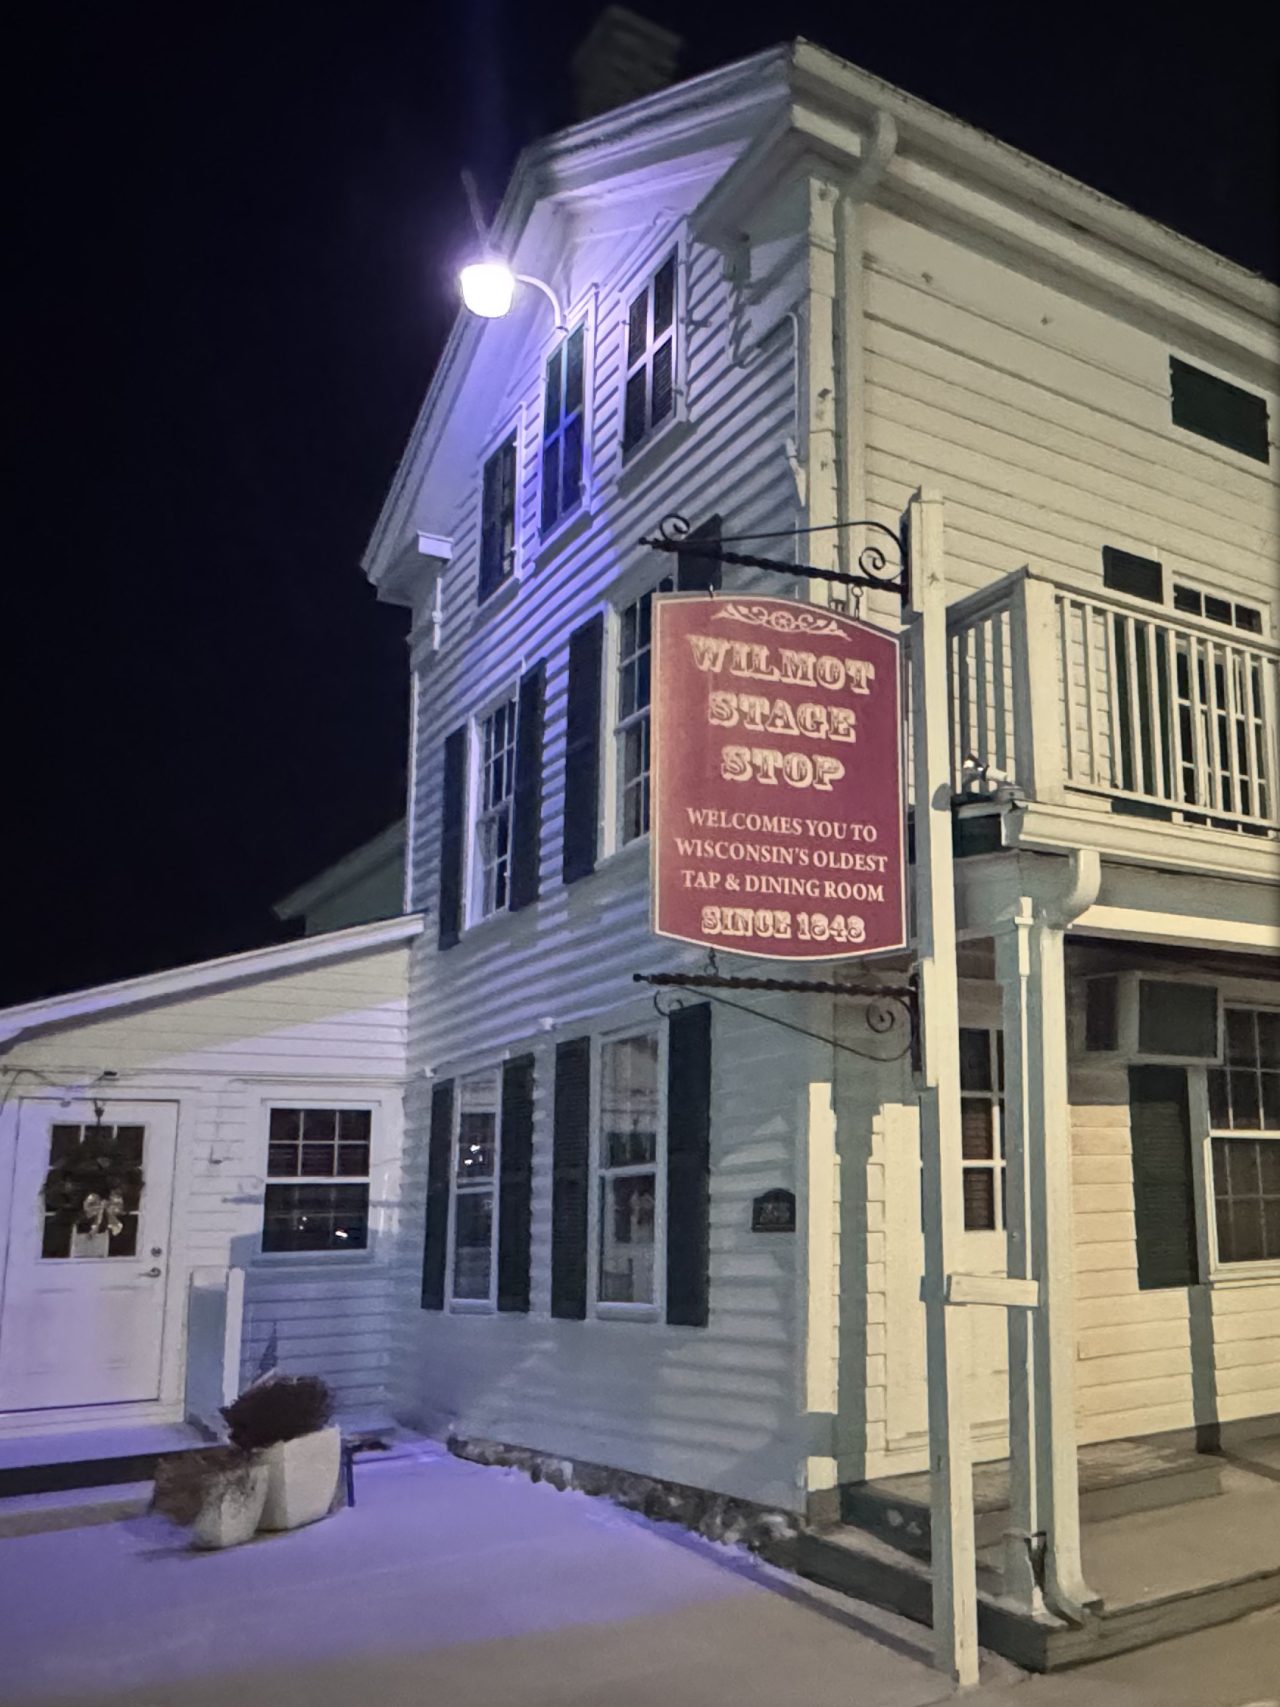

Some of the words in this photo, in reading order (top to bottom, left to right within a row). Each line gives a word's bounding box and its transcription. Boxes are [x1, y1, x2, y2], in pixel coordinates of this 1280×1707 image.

[688, 635, 875, 694] WILMOT
[709, 691, 857, 743] STAGE
[721, 745, 846, 792] STOP
[686, 807, 802, 836] WELCOMES
[805, 818, 847, 840] YOU
[850, 824, 878, 843] TO
[675, 837, 809, 867] WISCONSIN'S
[813, 849, 889, 873] OLDEST
[681, 870, 721, 889] TAP
[724, 873, 740, 891] &
[744, 874, 820, 898] DINING
[823, 880, 885, 902] ROOM
[701, 905, 792, 939] SINCE
[796, 911, 866, 943] 1848
